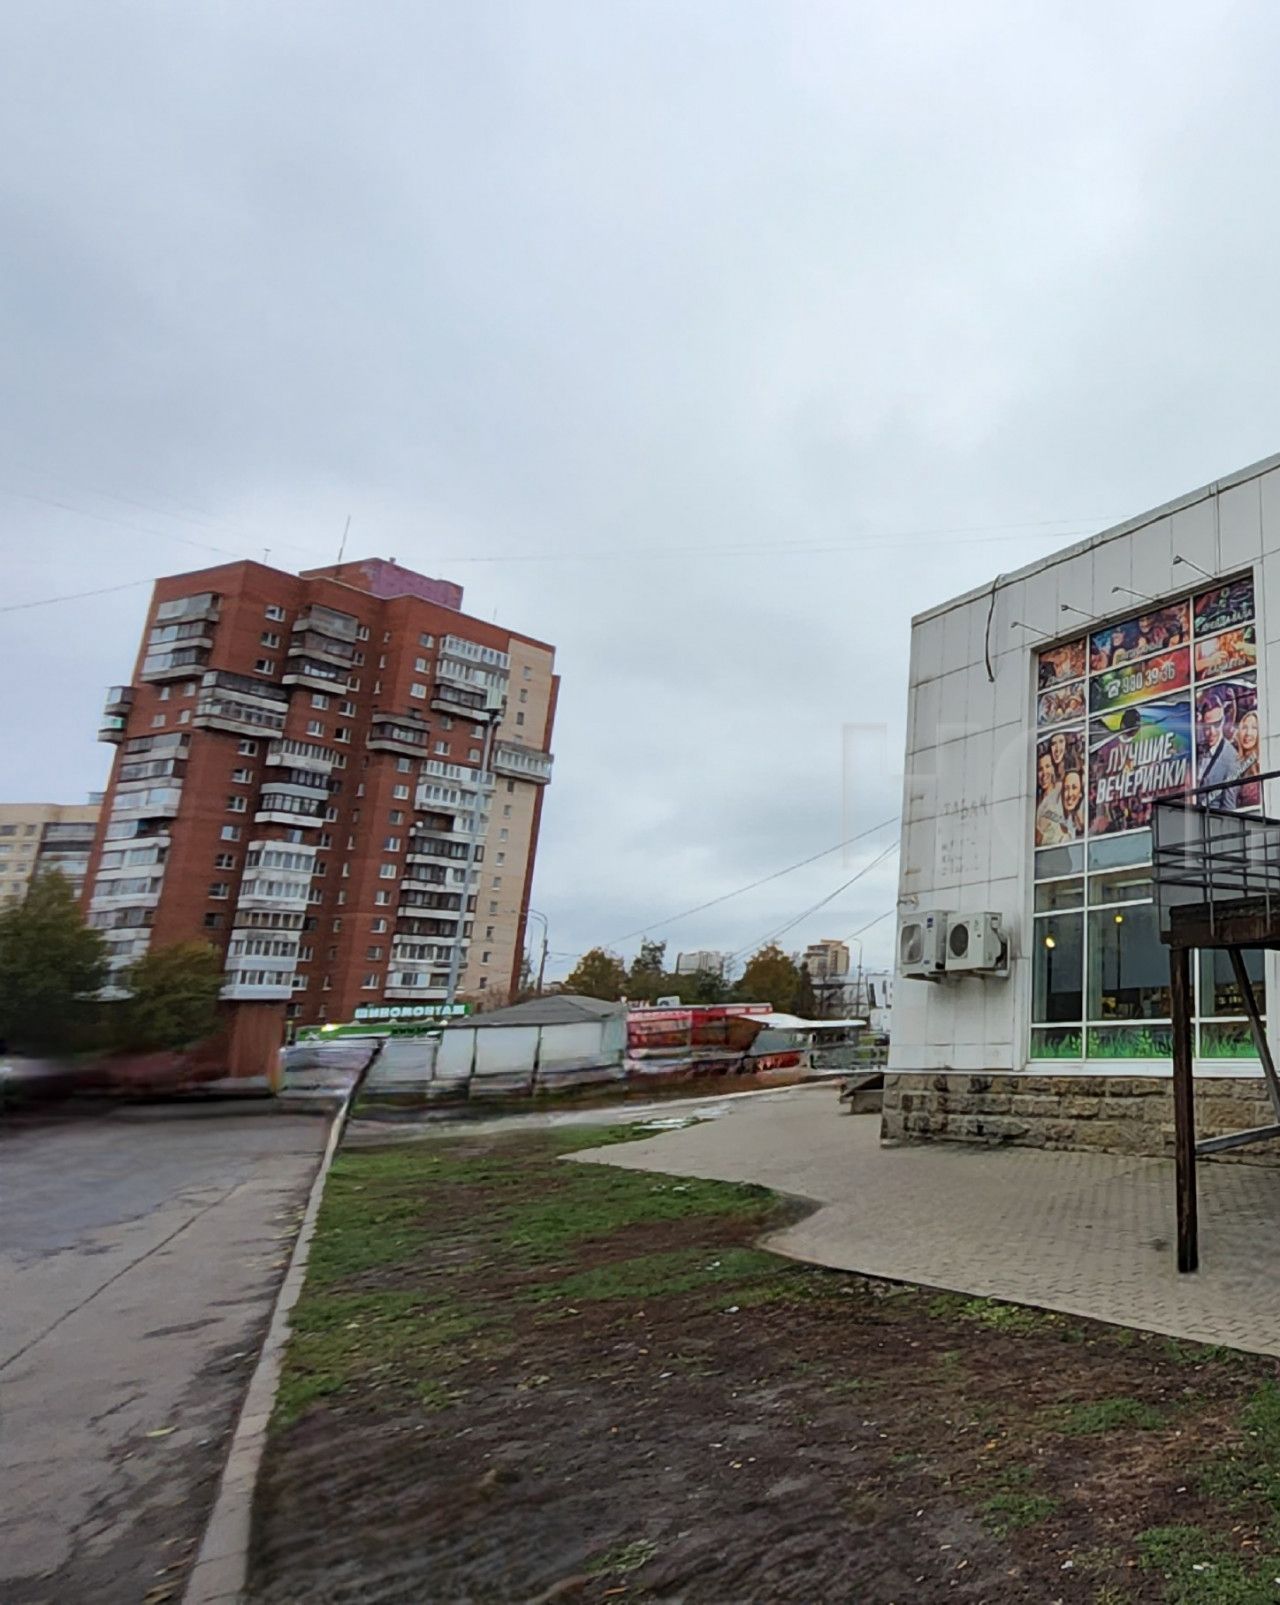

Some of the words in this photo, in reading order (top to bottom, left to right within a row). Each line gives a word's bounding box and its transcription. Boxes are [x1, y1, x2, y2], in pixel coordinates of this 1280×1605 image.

[1105, 731, 1175, 775] ЛУЧШИЕ
[1095, 758, 1187, 805] ВЕЧЕРИНКИ
[355, 1004, 466, 1020] ШИНОМОНТАЖ
